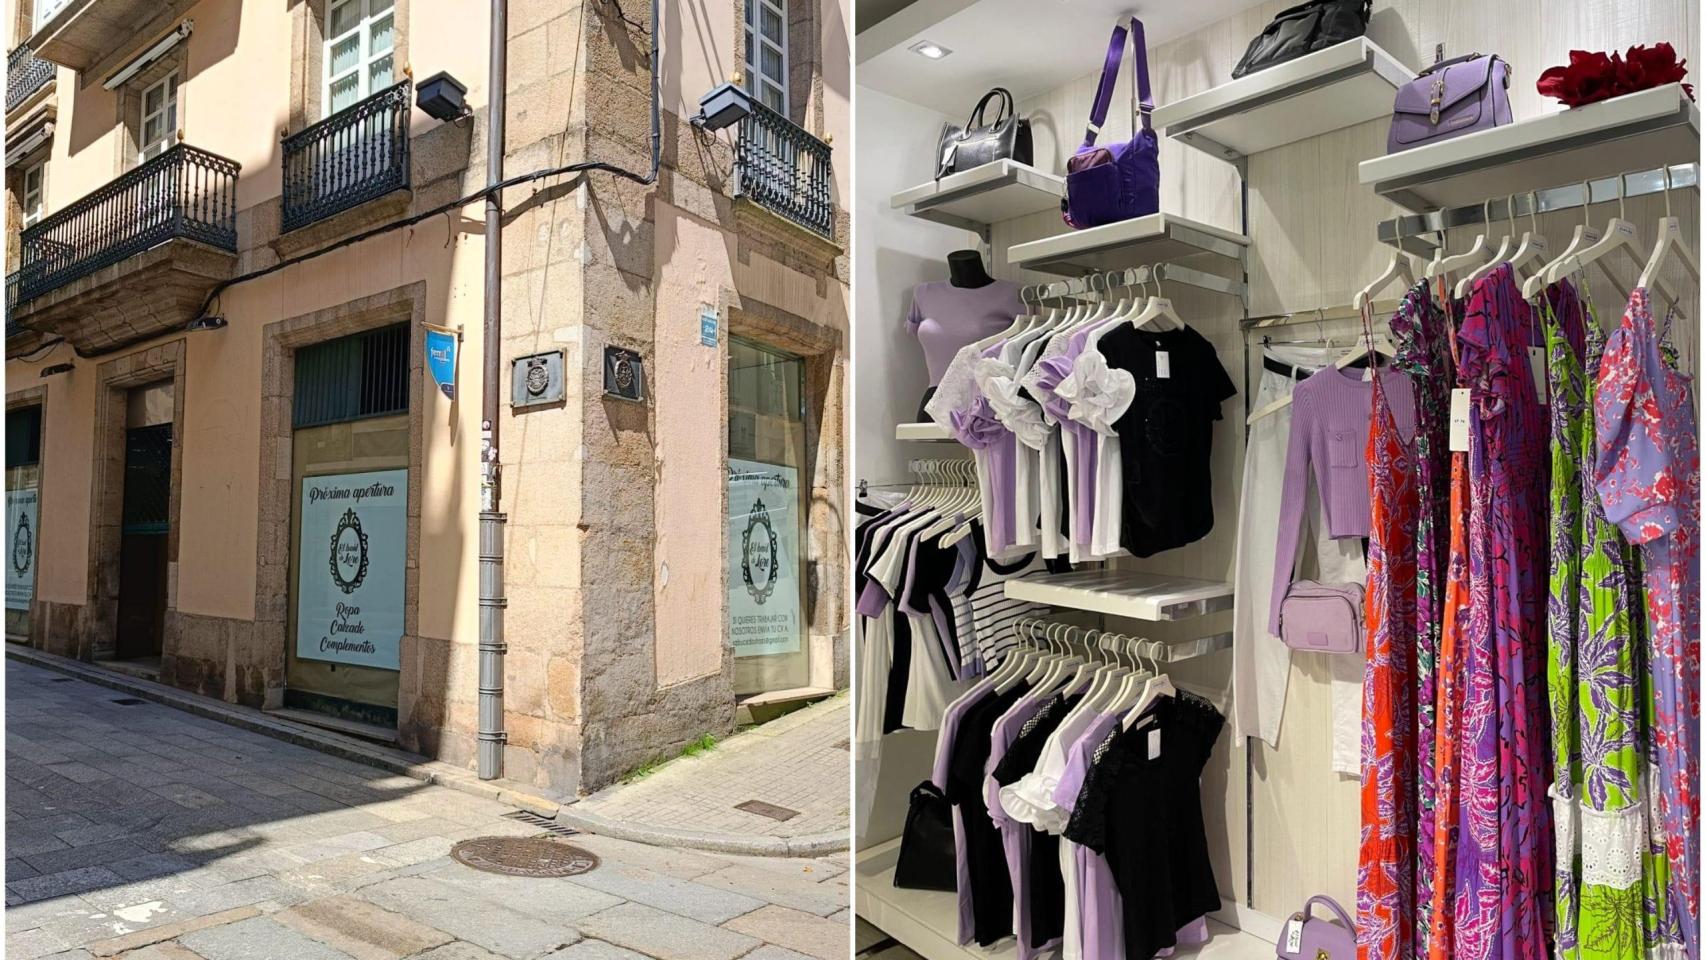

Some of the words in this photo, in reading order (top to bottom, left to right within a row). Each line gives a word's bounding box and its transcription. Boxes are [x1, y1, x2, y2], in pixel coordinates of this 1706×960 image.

[309, 486, 350, 504] Próxima
[352, 481, 394, 503] apertura
[336, 601, 360, 624] Ropa
[330, 619, 365, 635] Calzado
[320, 636, 376, 654] Complementos
